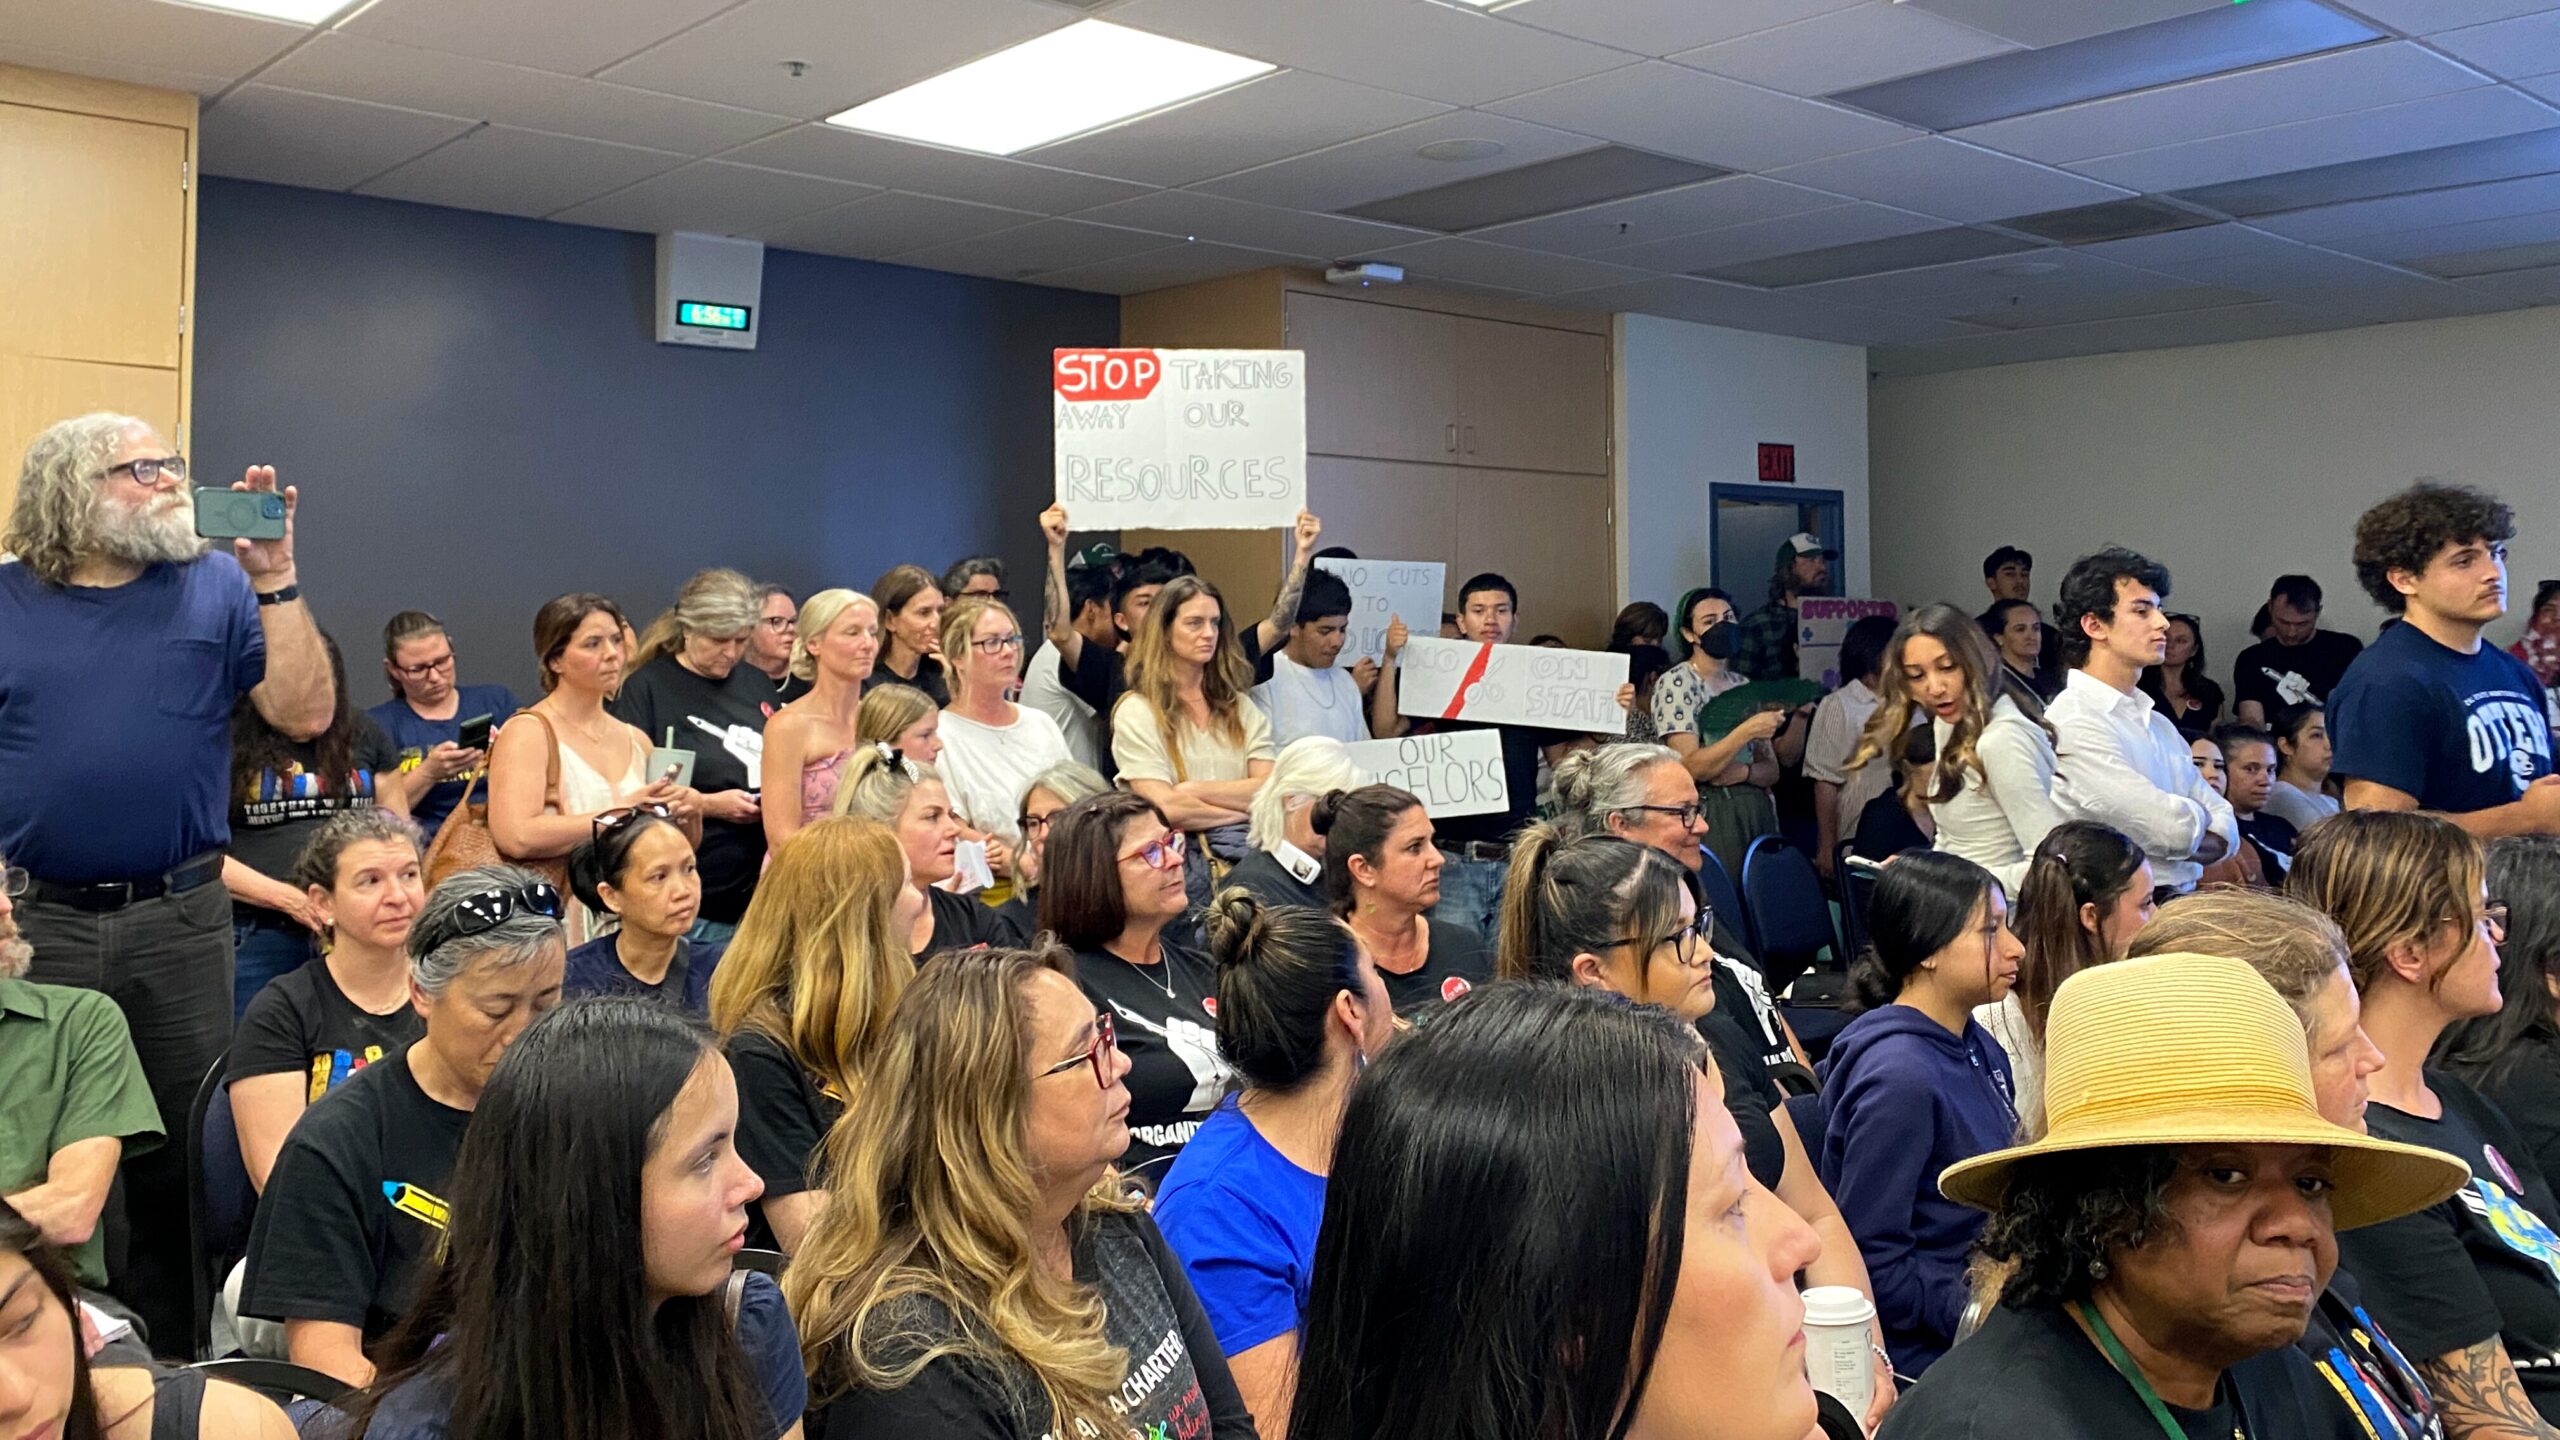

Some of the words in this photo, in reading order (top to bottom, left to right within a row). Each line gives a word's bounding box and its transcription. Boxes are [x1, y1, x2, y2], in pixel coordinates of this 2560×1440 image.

[1057, 354, 1155, 392] STOP
[1169, 358, 1294, 390] TAKING
[1056, 402, 1131, 430] AWAY
[1184, 400, 1249, 428] OUR
[1066, 454, 1291, 502] RESOURCES
[1759, 447, 1793, 480] EXIT
[1387, 568, 1432, 586] CUTS
[1361, 595, 1389, 613] TO
[1405, 645, 1460, 673] NO
[1531, 655, 1589, 681] ON
[1399, 734, 1456, 765] OUR
[1121, 1329, 1184, 1408] CHARTER
